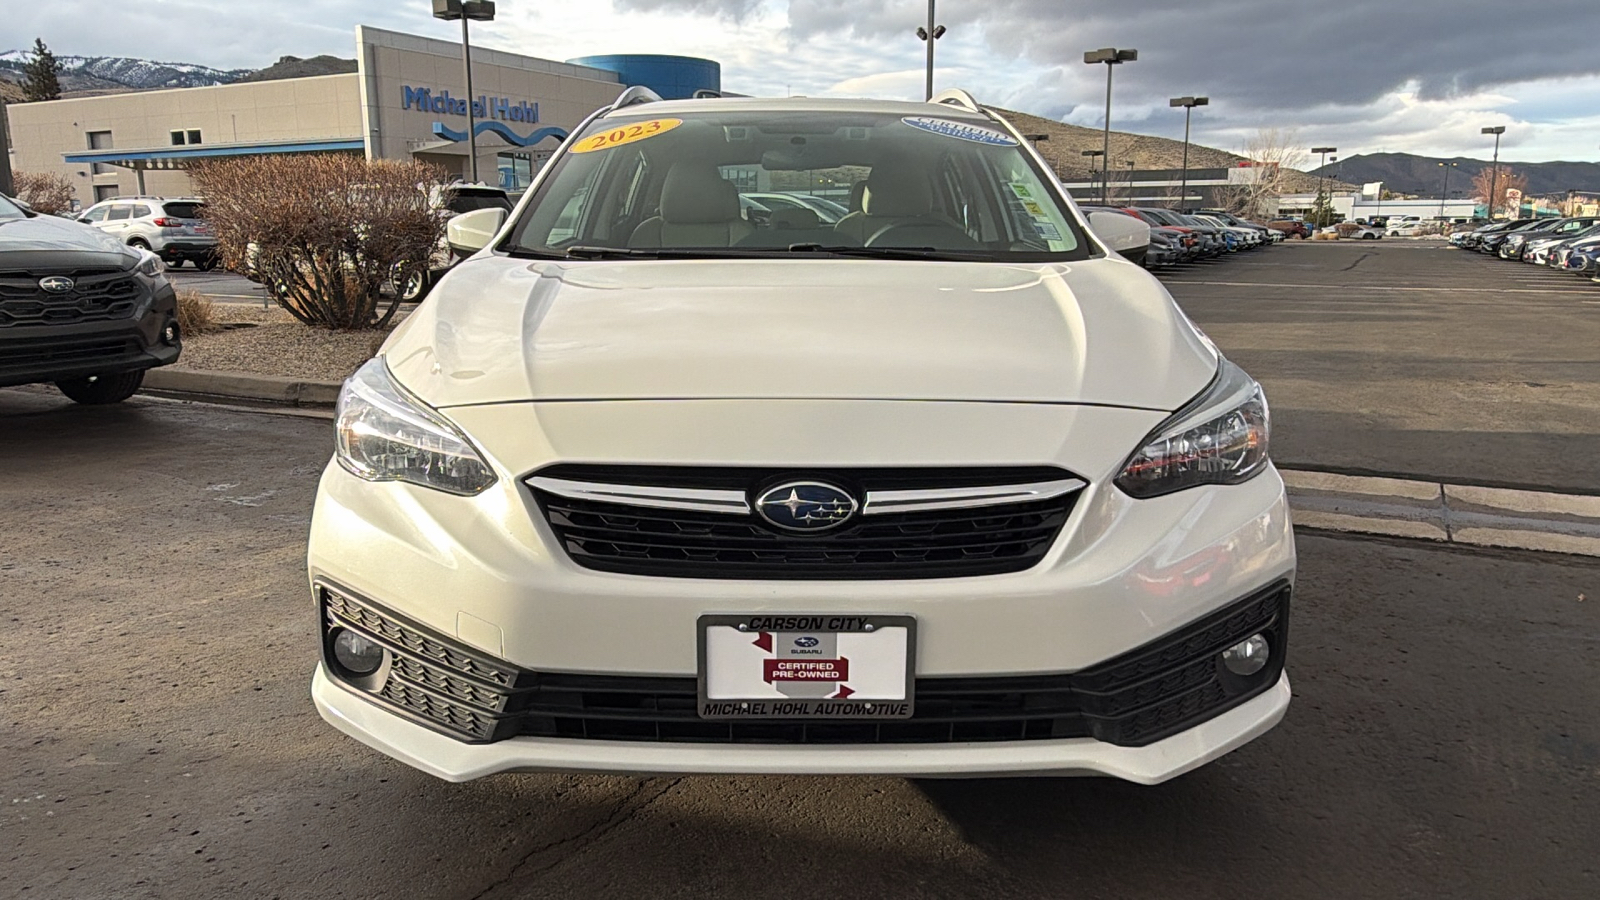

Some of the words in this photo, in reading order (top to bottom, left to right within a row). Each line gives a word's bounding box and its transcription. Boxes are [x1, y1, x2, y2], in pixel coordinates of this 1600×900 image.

[401, 85, 487, 118] Michael
[490, 97, 539, 123] Hohl
[591, 121, 661, 149] 2023
[749, 617, 823, 630] CARSON
[828, 617, 869, 630] CITY
[777, 662, 835, 670] CERTIFIED
[772, 671, 840, 679] PRE-OWNED
[703, 703, 768, 715] MICHAEL
[771, 703, 810, 715] HOHL
[814, 703, 909, 715] AUTOMOTIVE
